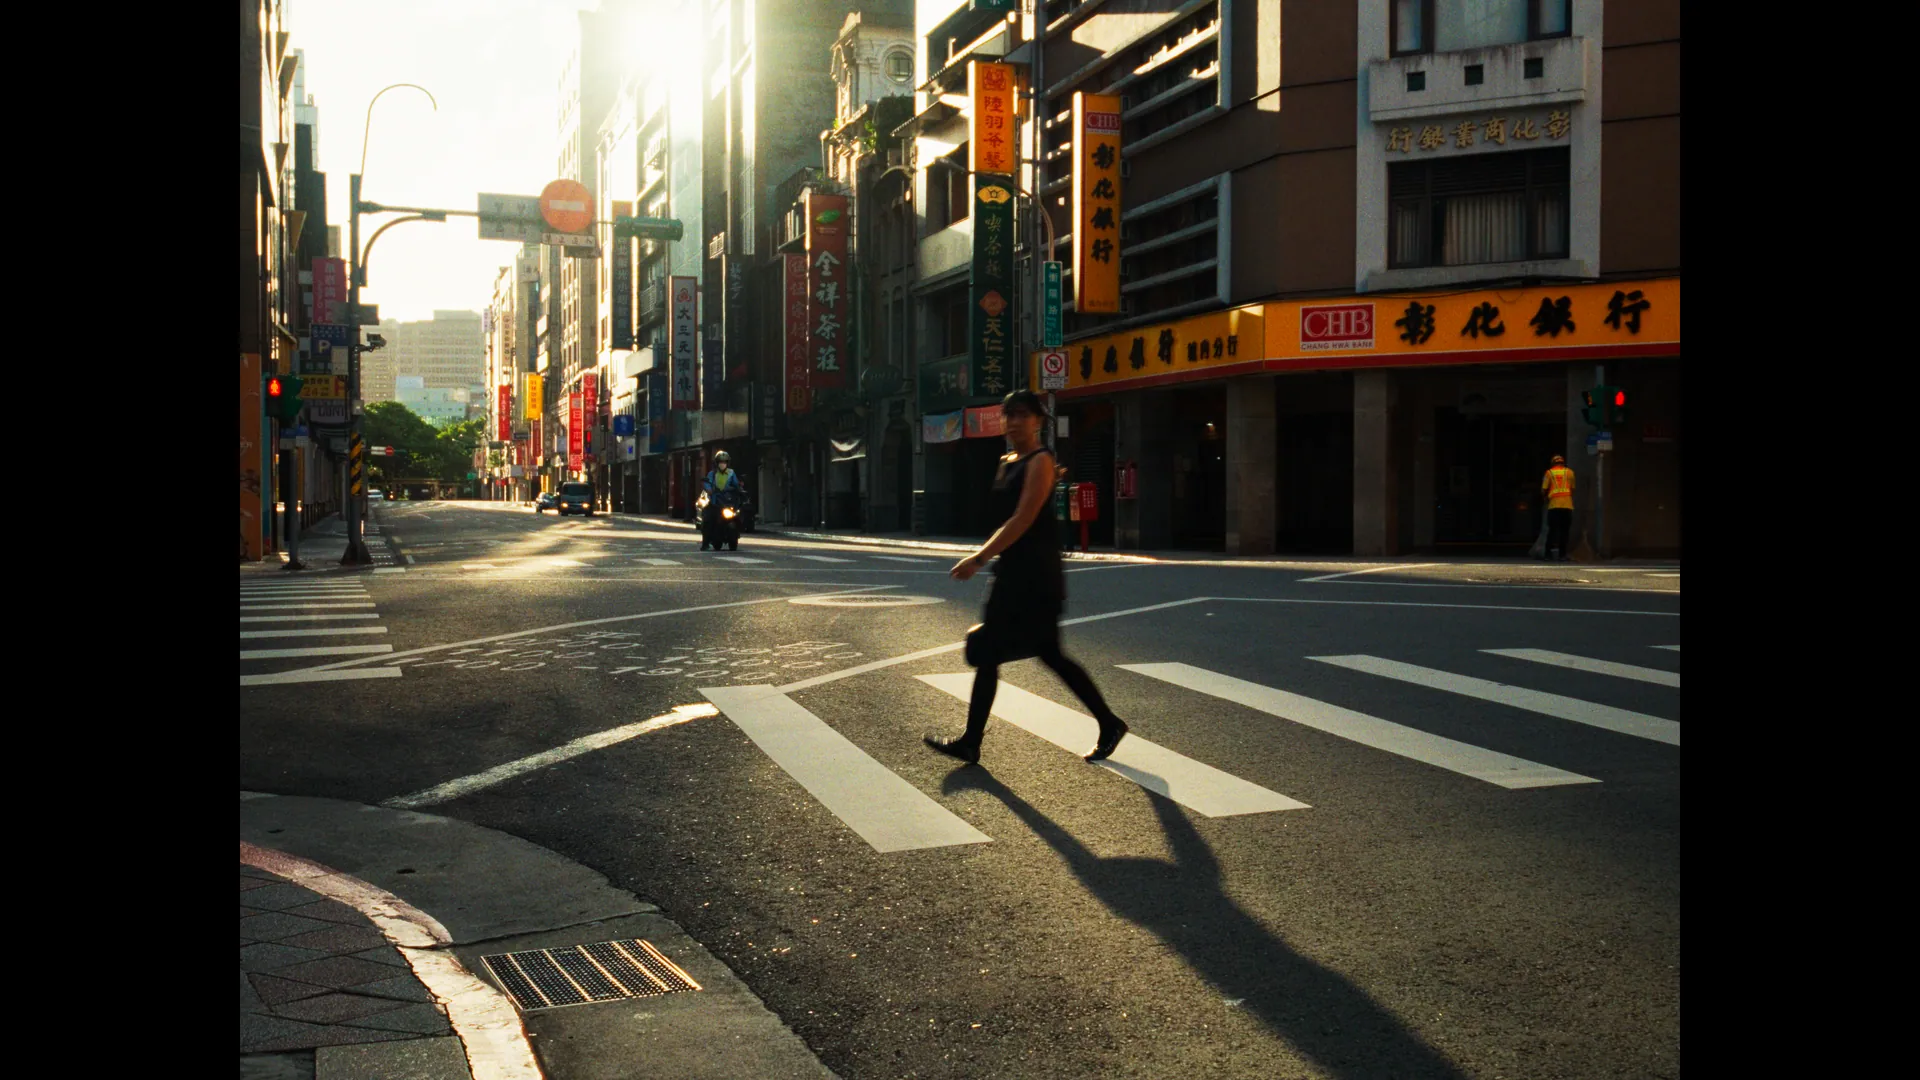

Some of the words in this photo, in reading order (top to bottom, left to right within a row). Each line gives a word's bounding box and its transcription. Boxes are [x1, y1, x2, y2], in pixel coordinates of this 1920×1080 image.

[1090, 142, 1115, 264] 彰化銀行
[814, 250, 841, 373] 全祥茶莊
[1304, 308, 1371, 338] CHB
[1395, 289, 1651, 344] 彰化銀行
[981, 318, 1004, 395] 天仁茗茶
[1301, 342, 1330, 351] CHANG
[1332, 341, 1350, 349] HWA
[1352, 340, 1373, 349] BANK
